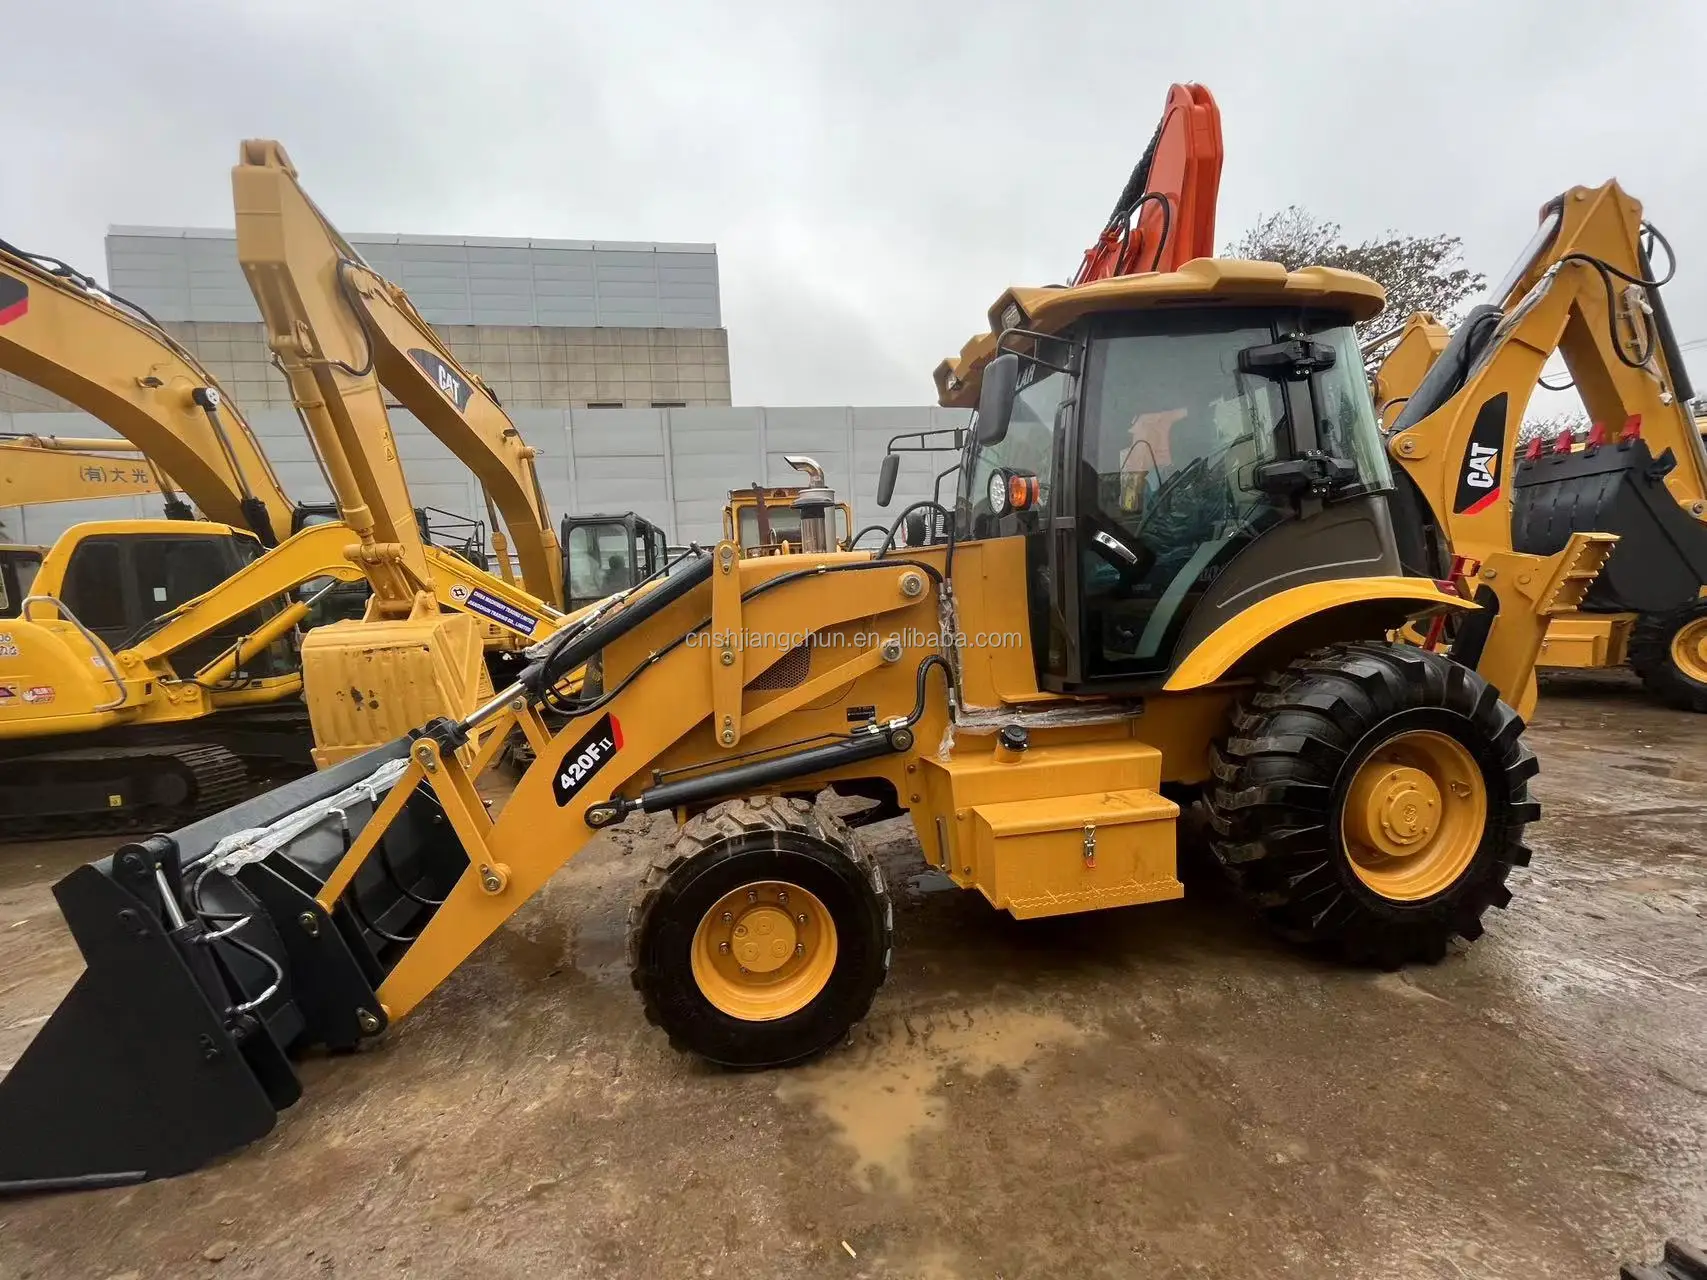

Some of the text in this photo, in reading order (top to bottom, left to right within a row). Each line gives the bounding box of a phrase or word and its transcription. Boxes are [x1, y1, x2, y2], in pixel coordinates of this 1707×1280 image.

[438, 364, 460, 405] CAT
[1467, 442, 1498, 488] CAT
[560, 742, 601, 790] 420F
